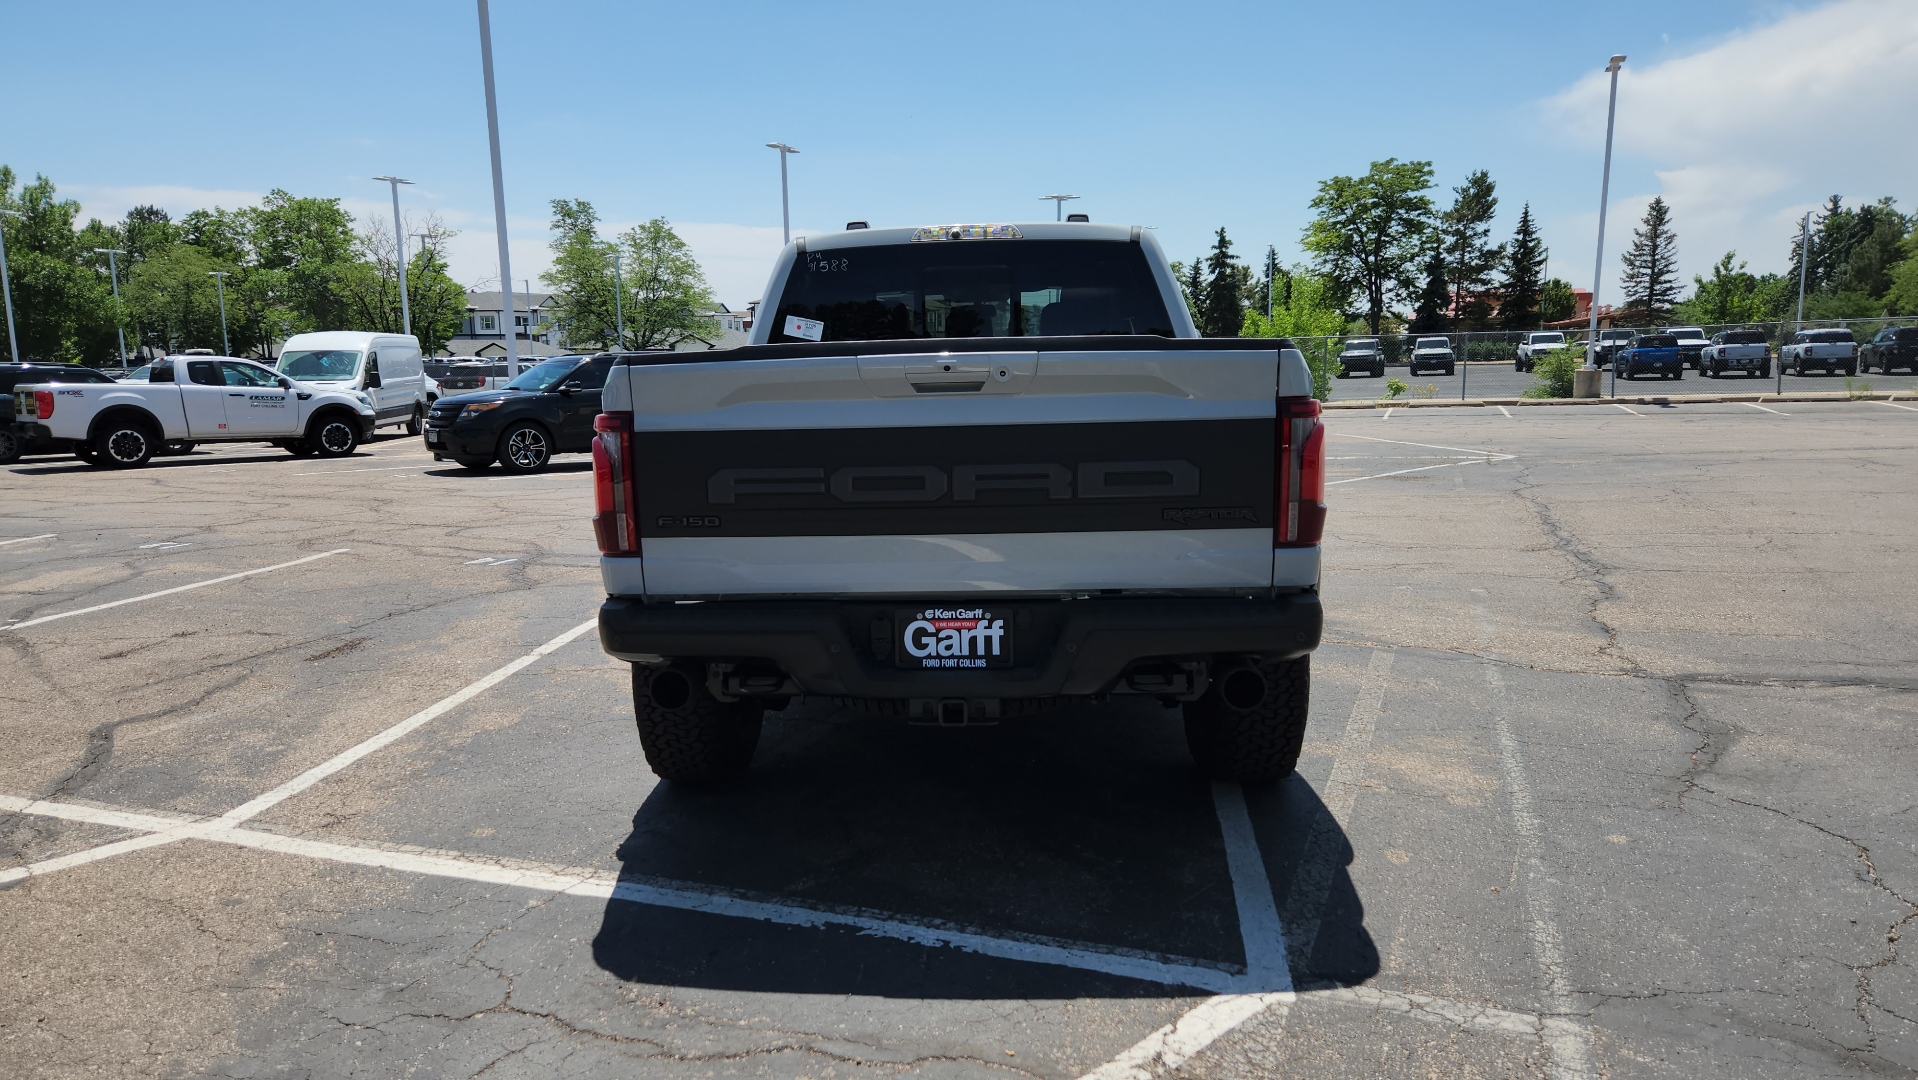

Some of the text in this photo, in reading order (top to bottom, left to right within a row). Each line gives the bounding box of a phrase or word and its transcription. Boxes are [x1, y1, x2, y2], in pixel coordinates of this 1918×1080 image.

[706, 460, 1201, 504] FORD
[1162, 507, 1260, 525] RAPTOR
[934, 608, 983, 619] Ken Garff
[903, 619, 1004, 658] Garff
[922, 659, 987, 668] FORD FORT COLLINS
